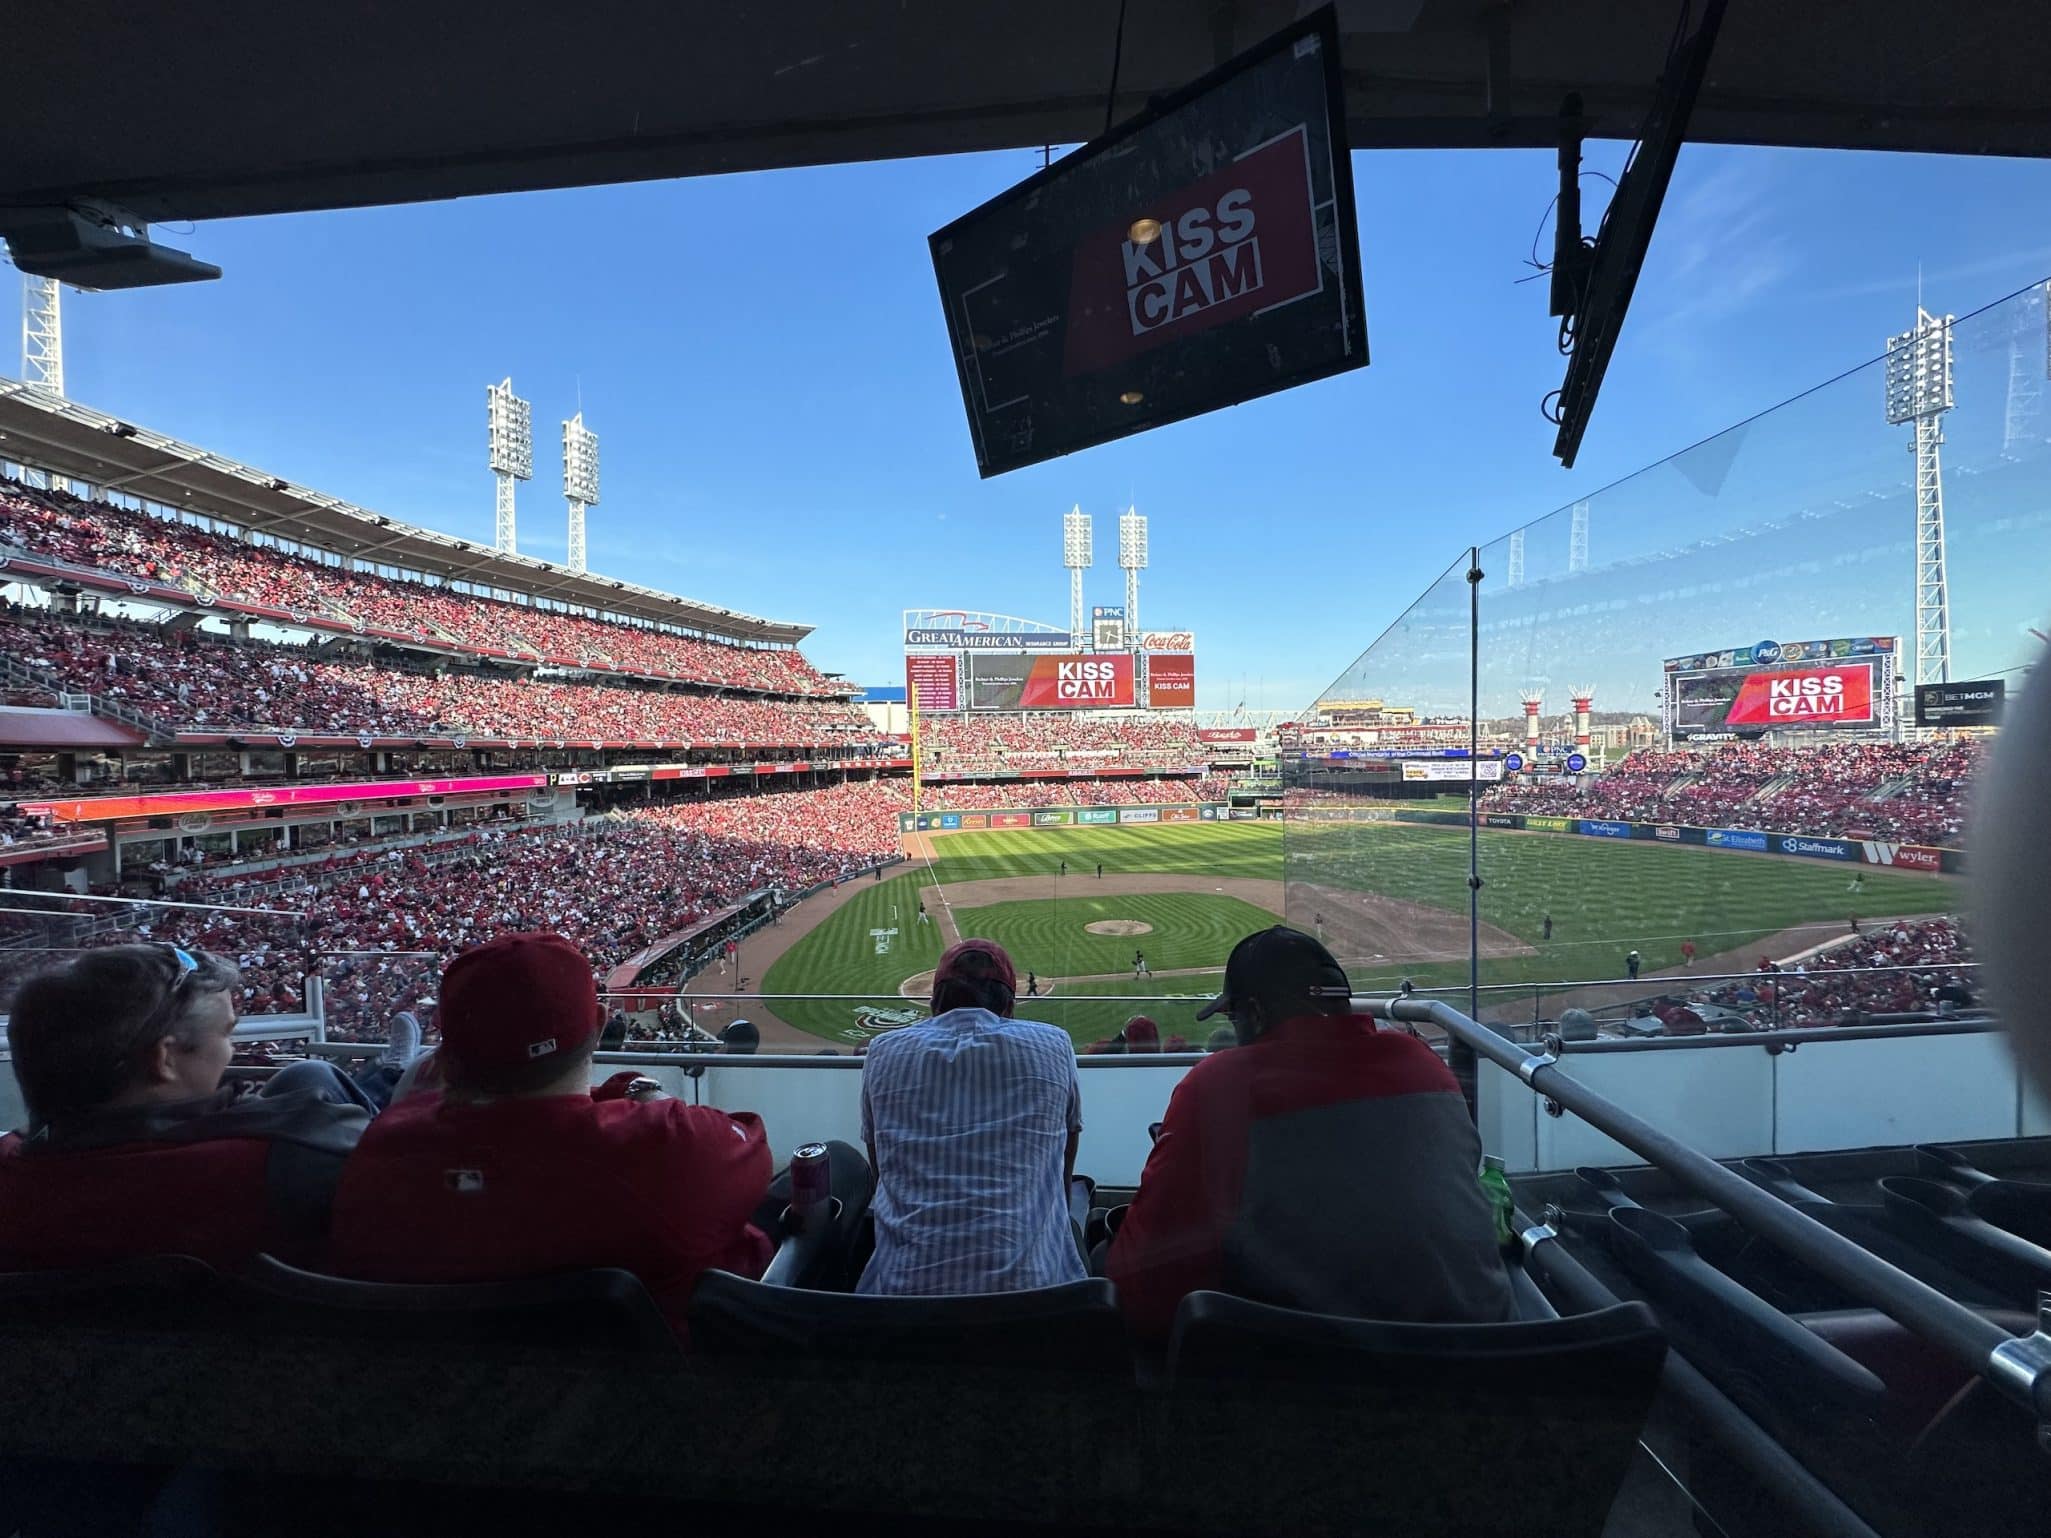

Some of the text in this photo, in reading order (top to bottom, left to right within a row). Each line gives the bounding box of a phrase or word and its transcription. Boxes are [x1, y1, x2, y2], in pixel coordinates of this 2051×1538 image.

[1121, 188, 1255, 286] KISS
[1135, 242, 1258, 328] CAM
[1103, 607, 1123, 617] PNC
[908, 630, 956, 643] GREAT
[952, 634, 1022, 647] AMERICAN
[1757, 646, 1779, 658] P&G
[1058, 661, 1115, 680] KISS
[1060, 681, 1113, 698] CAM
[1172, 682, 1190, 690] CAM
[1770, 675, 1844, 697] KISS
[1772, 696, 1841, 714] CAM
[1944, 692, 1995, 701] BETMGM
[1692, 733, 1737, 741] GRAVITY
[1798, 841, 1845, 855] Staffmark
